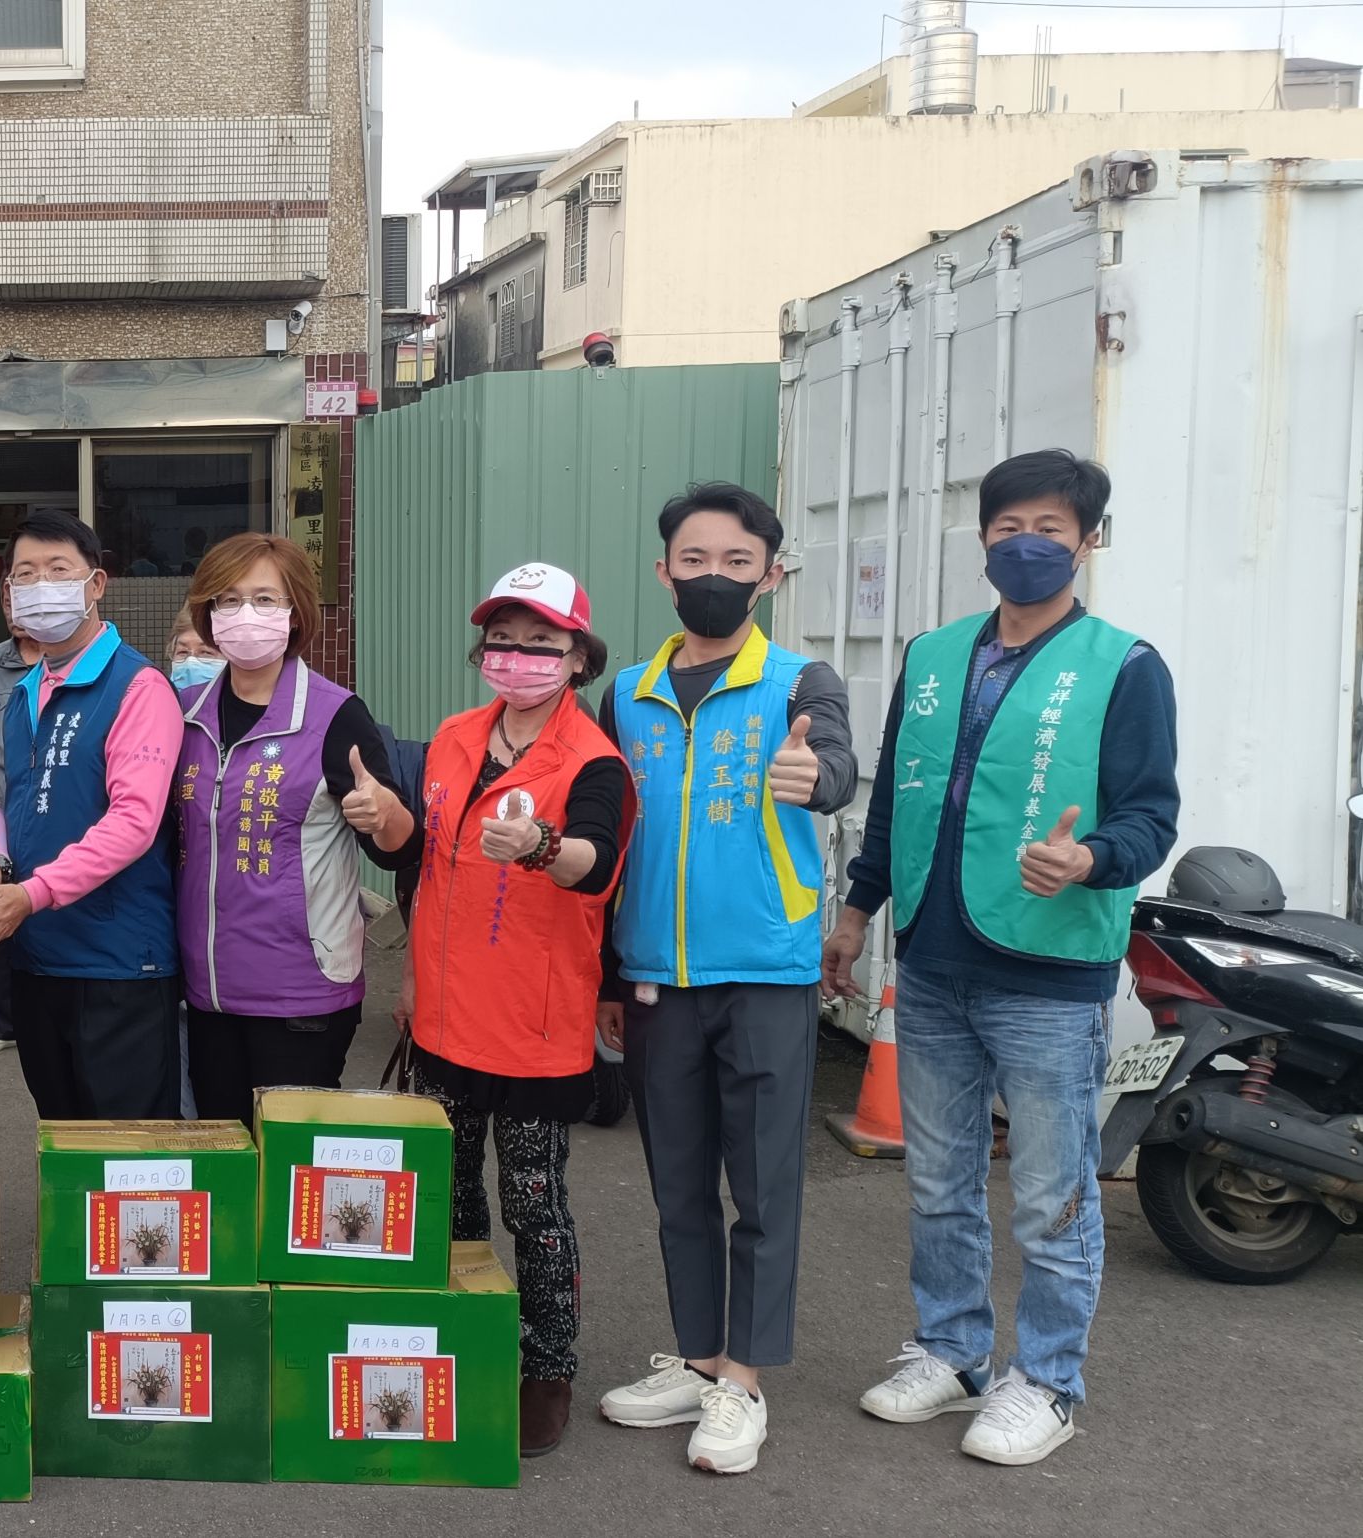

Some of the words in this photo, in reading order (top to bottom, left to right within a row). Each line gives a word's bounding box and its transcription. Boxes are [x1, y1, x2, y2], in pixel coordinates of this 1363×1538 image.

[321, 396, 347, 413] 42
[300, 431, 313, 471] 龍潭區
[317, 431, 331, 469] 桃園市
[58, 712, 81, 766] 凌雲里
[898, 674, 940, 790] 志工
[181, 763, 200, 800] 助理
[706, 729, 737, 824] 徐玉樹
[742, 714, 763, 808] 桃園市議員
[237, 762, 263, 873] 感恩服務團隊
